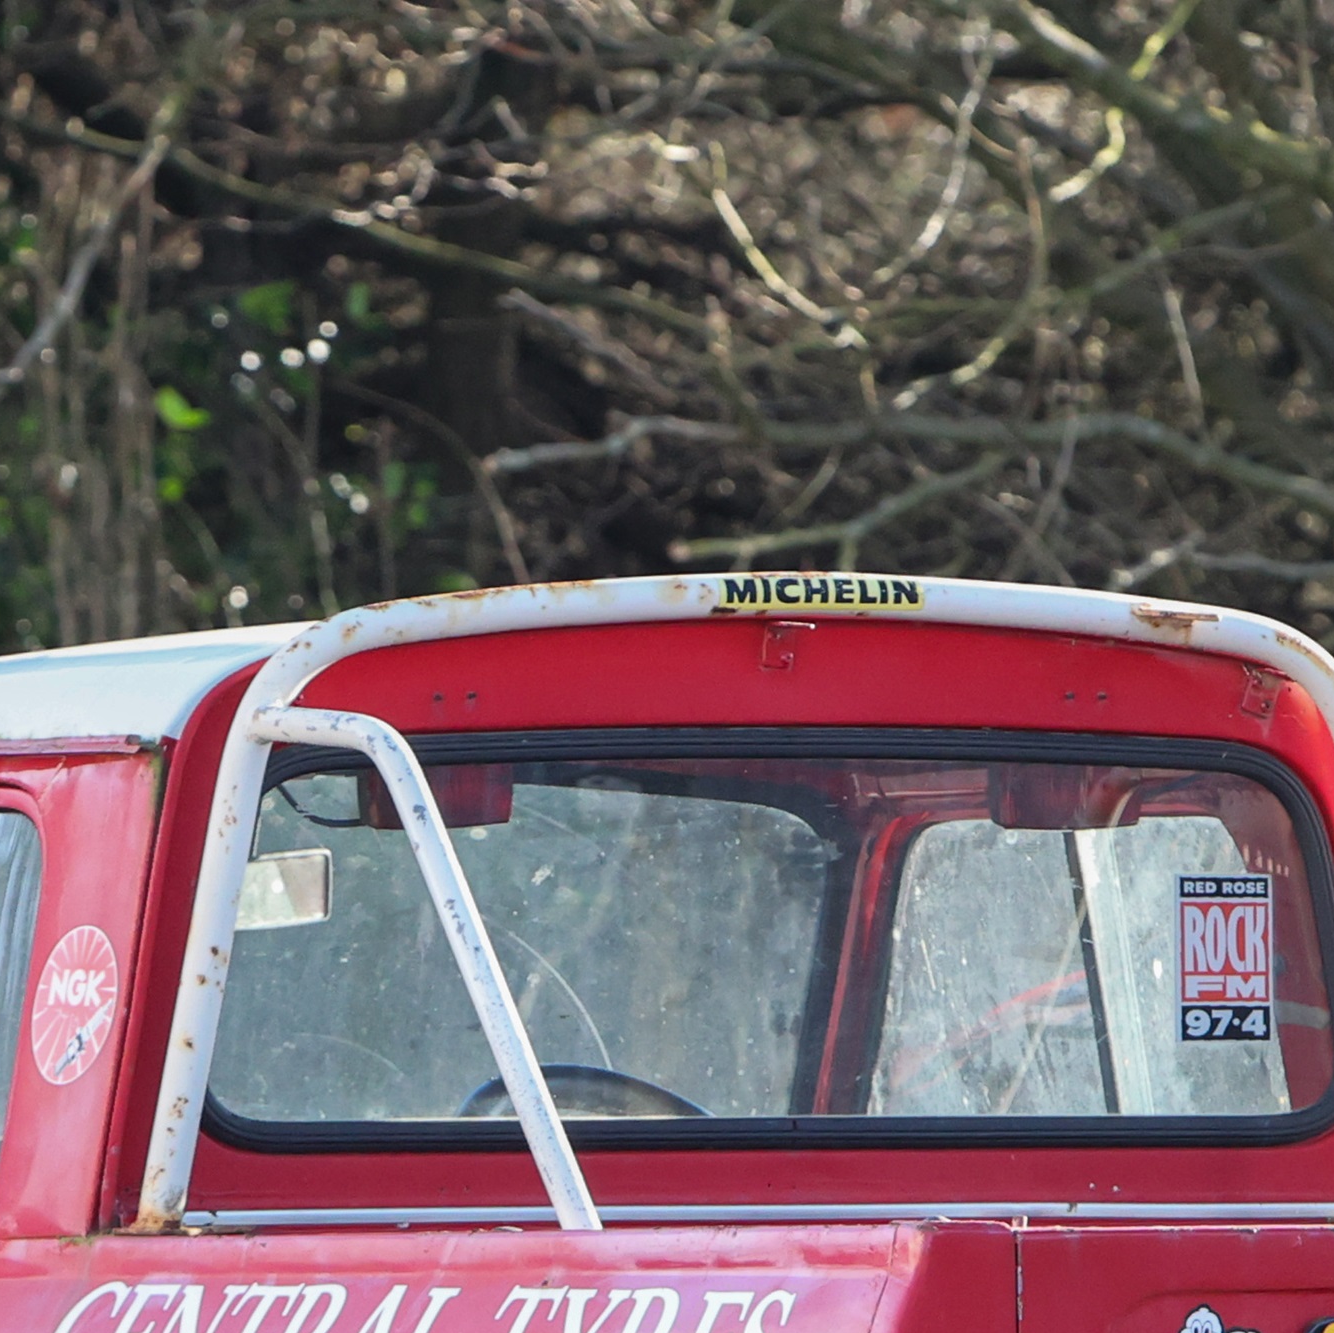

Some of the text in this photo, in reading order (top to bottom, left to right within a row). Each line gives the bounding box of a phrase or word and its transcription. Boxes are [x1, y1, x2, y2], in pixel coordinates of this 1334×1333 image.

[723, 578, 919, 604] MICHELIN
[1183, 881, 1265, 894] RED ROSE
[1184, 905, 1266, 973] ROCK
[47, 968, 106, 1007] NGK
[1184, 975, 1266, 999] FM
